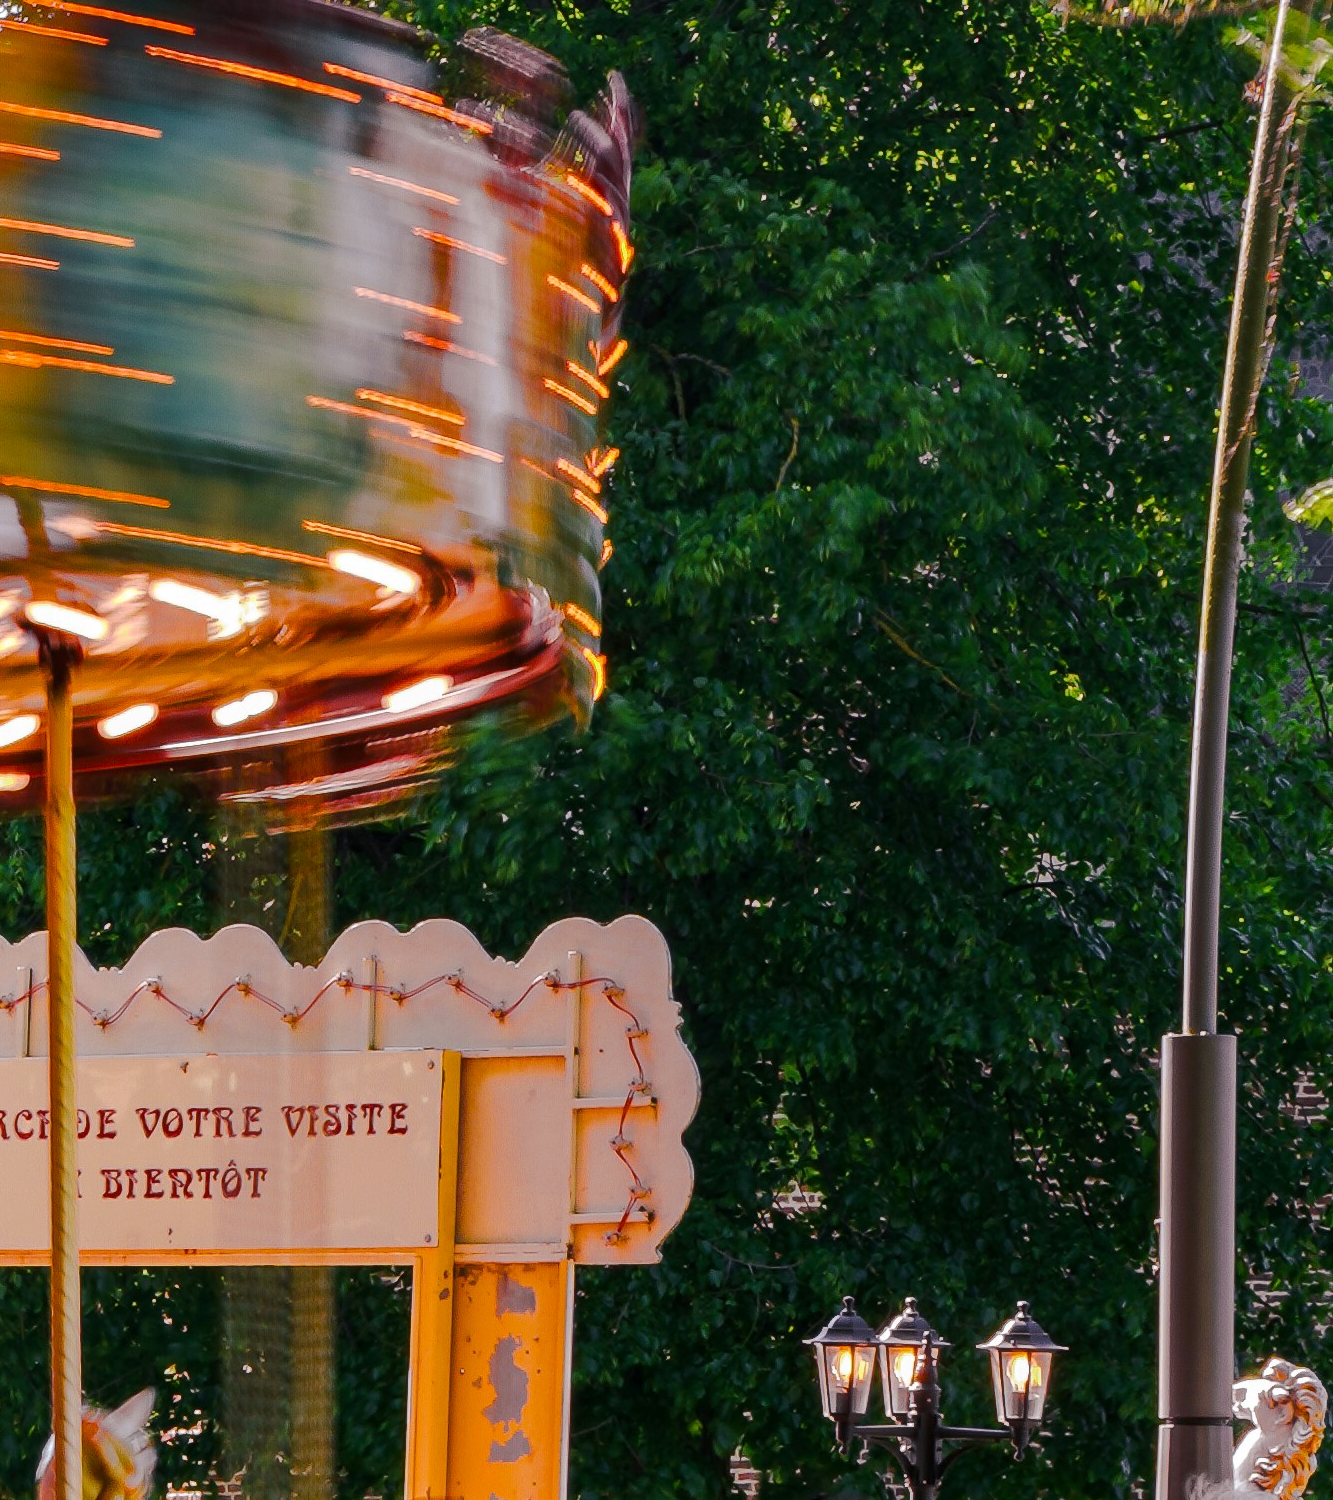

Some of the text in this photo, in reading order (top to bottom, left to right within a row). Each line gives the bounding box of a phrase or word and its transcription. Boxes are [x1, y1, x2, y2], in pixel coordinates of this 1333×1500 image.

[135, 1106, 264, 1140] VOTRE
[281, 1102, 410, 1138] VISITE
[100, 1159, 269, 1200] BIENTÔT
